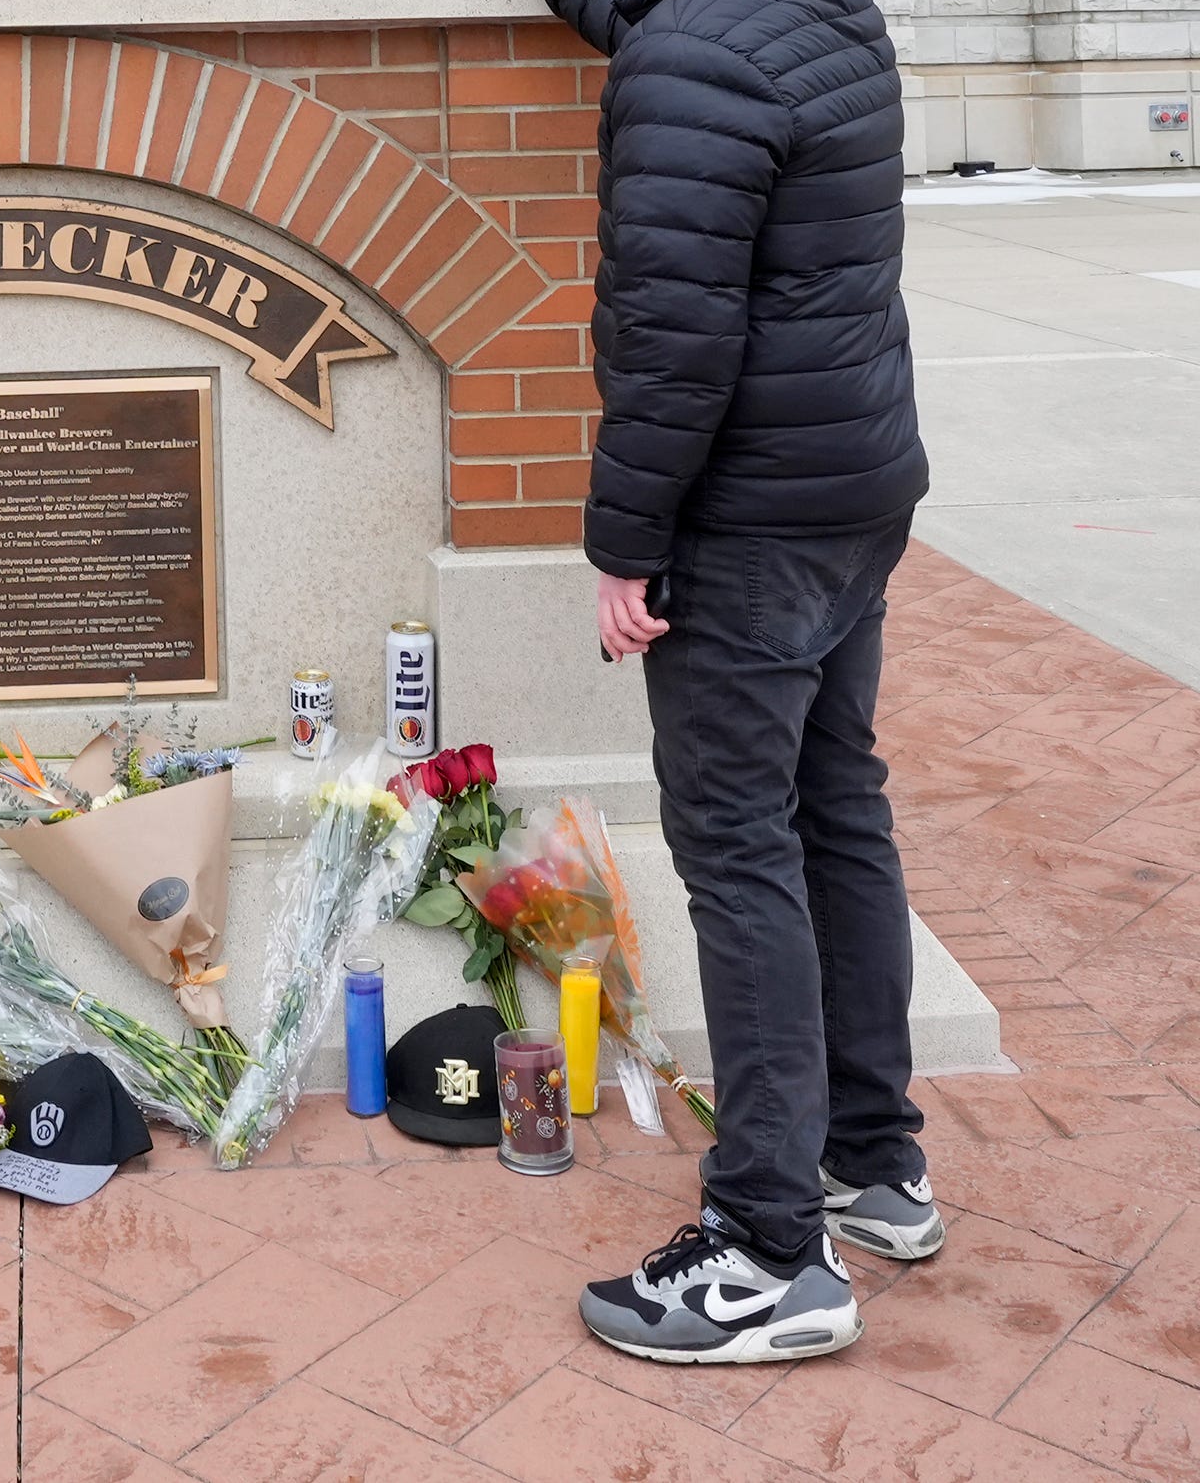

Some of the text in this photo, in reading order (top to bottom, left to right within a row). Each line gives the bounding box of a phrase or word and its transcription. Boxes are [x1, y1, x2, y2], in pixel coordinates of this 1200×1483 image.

[59, 427, 112, 438] Brewers
[20, 443, 43, 452] and
[46, 440, 121, 451] World-Class
[124, 438, 198, 449] Entertainer
[395, 650, 431, 712] Lite
[701, 1206, 724, 1225] NIKE
